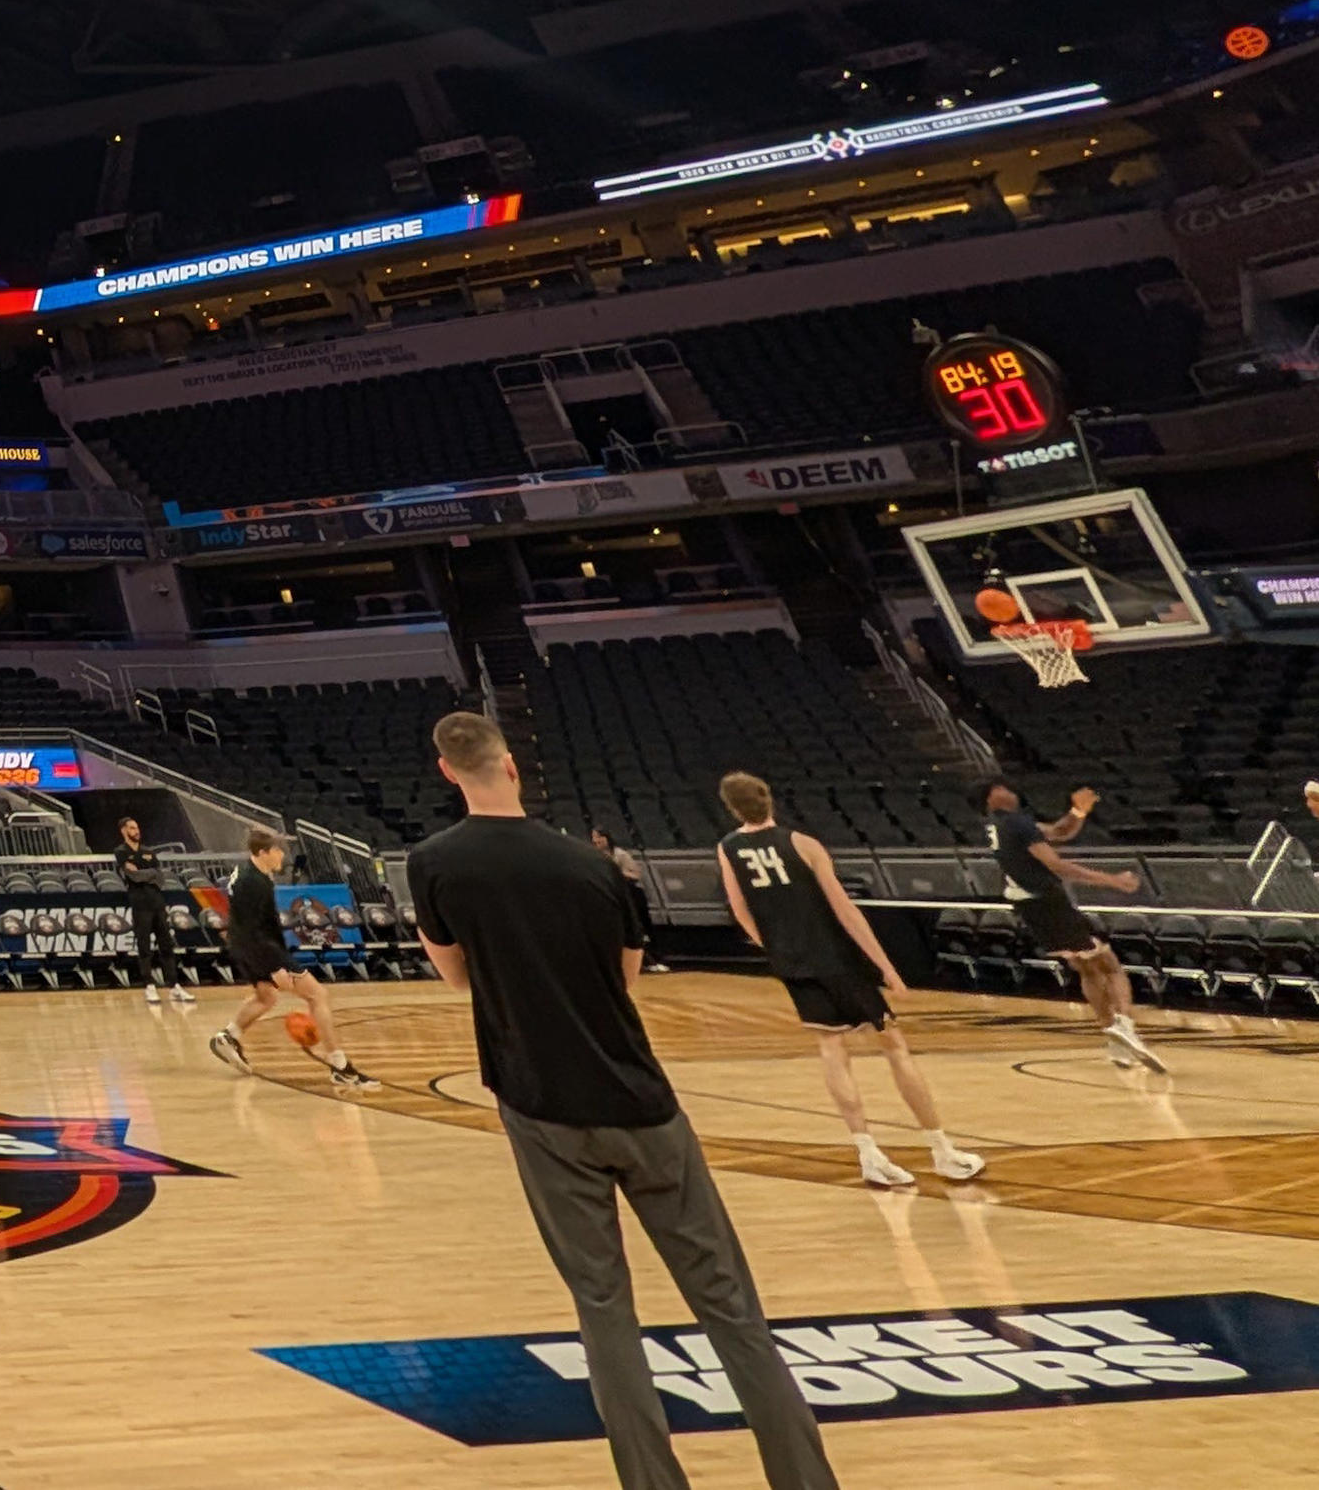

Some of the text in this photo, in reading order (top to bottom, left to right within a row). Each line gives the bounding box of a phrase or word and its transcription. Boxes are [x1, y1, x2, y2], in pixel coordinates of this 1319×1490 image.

[98, 219, 423, 296] CHAMPIONS WIN HERE
[940, 351, 1024, 393] 84:19
[958, 379, 1047, 440] 30
[1003, 442, 1077, 467] TISSOT
[772, 457, 886, 490] DEEM
[398, 502, 470, 520] FANDUEL
[69, 535, 143, 553] salesforce
[200, 522, 293, 546] IndyStar
[737, 846, 791, 888] 34
[995, 1309, 1178, 1352] IT
